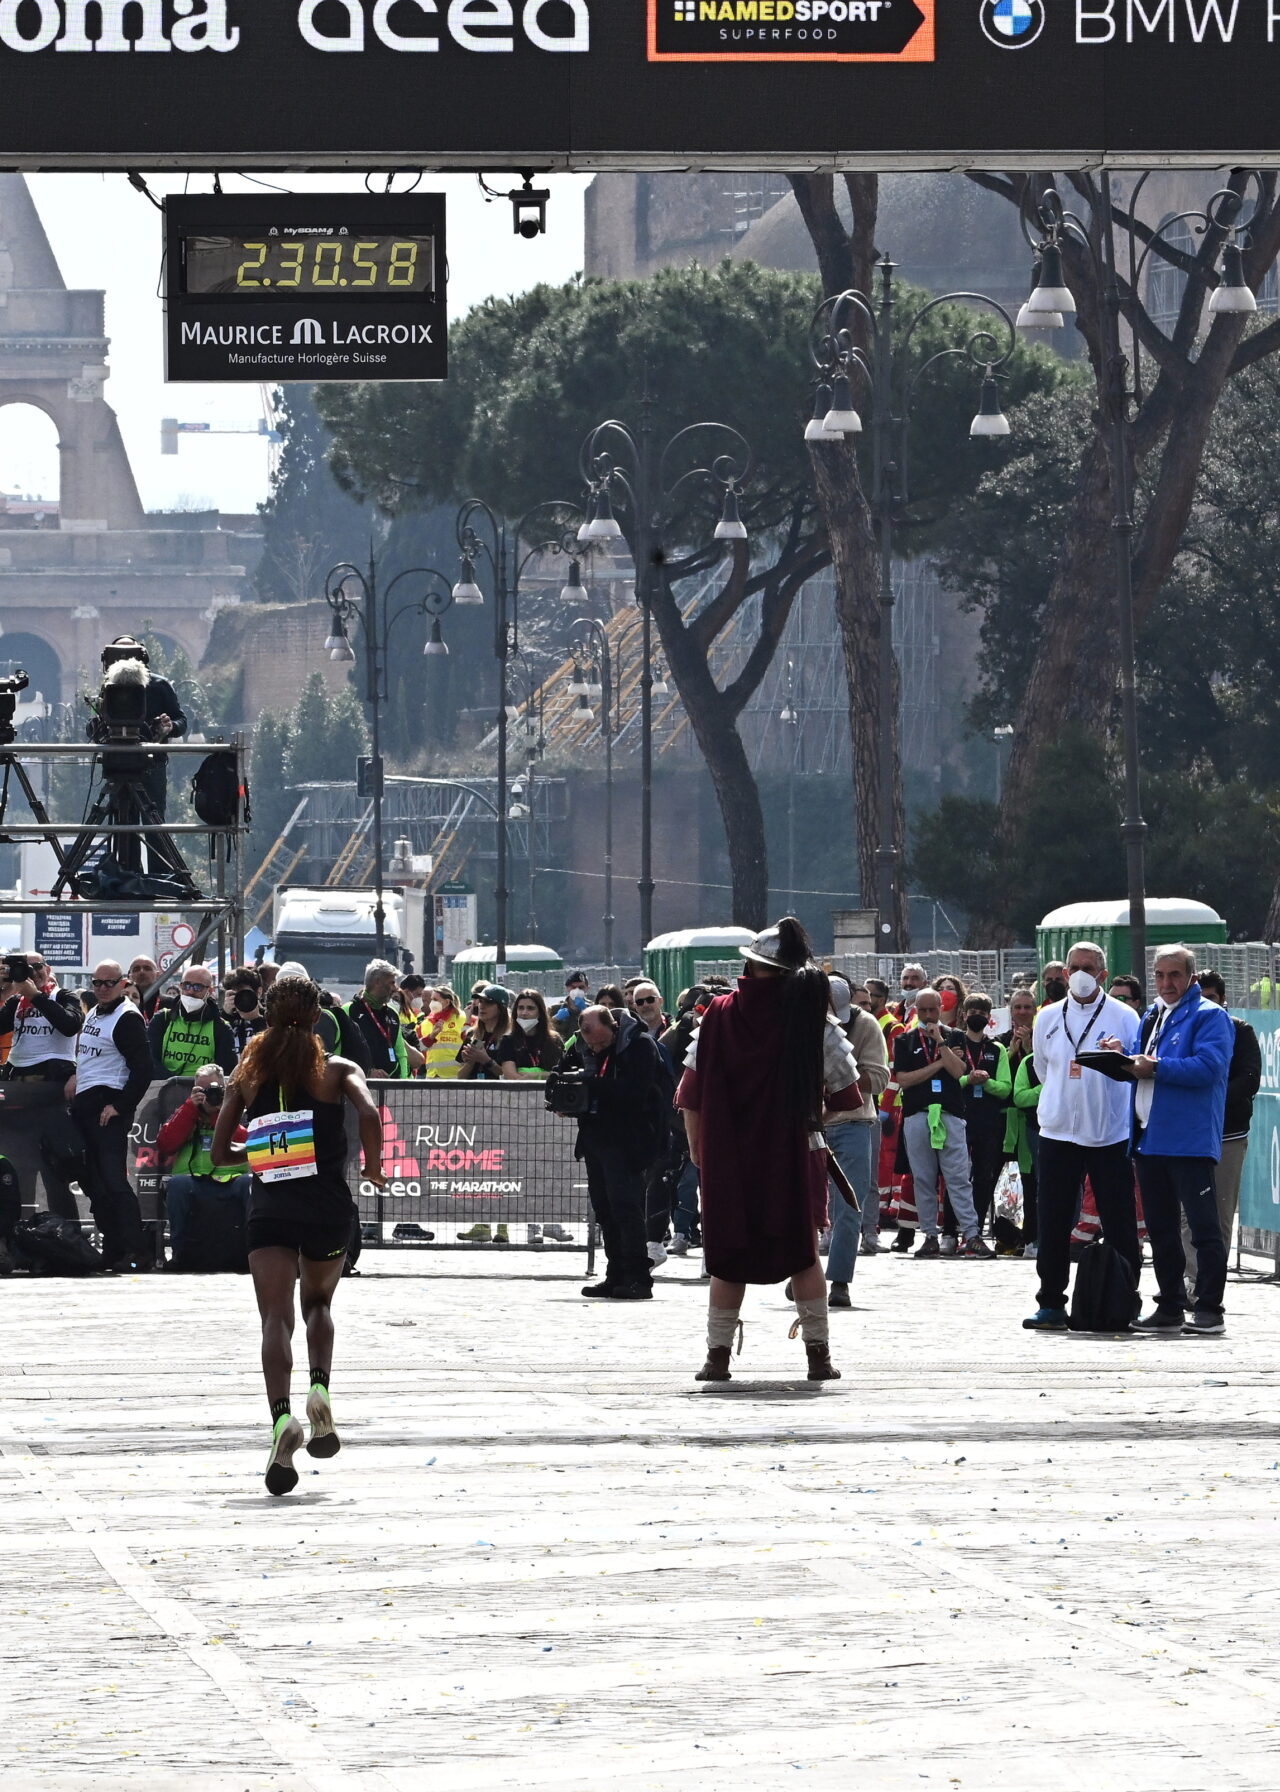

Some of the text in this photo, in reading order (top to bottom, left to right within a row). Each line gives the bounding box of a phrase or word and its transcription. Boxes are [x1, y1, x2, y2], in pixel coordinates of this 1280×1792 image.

[1075, 0, 1240, 43] BMW
[719, 28, 837, 40] SUPERFOOD
[181, 320, 433, 345] MAURICE LACROIX
[228, 351, 387, 366] Manufacture Horlogère Suisse
[268, 1130, 289, 1156] F4
[415, 1125, 477, 1147] RUN
[427, 1149, 505, 1171] ROME
[139, 1178, 157, 1187] THE
[430, 1181, 522, 1193] THE MARATHON
